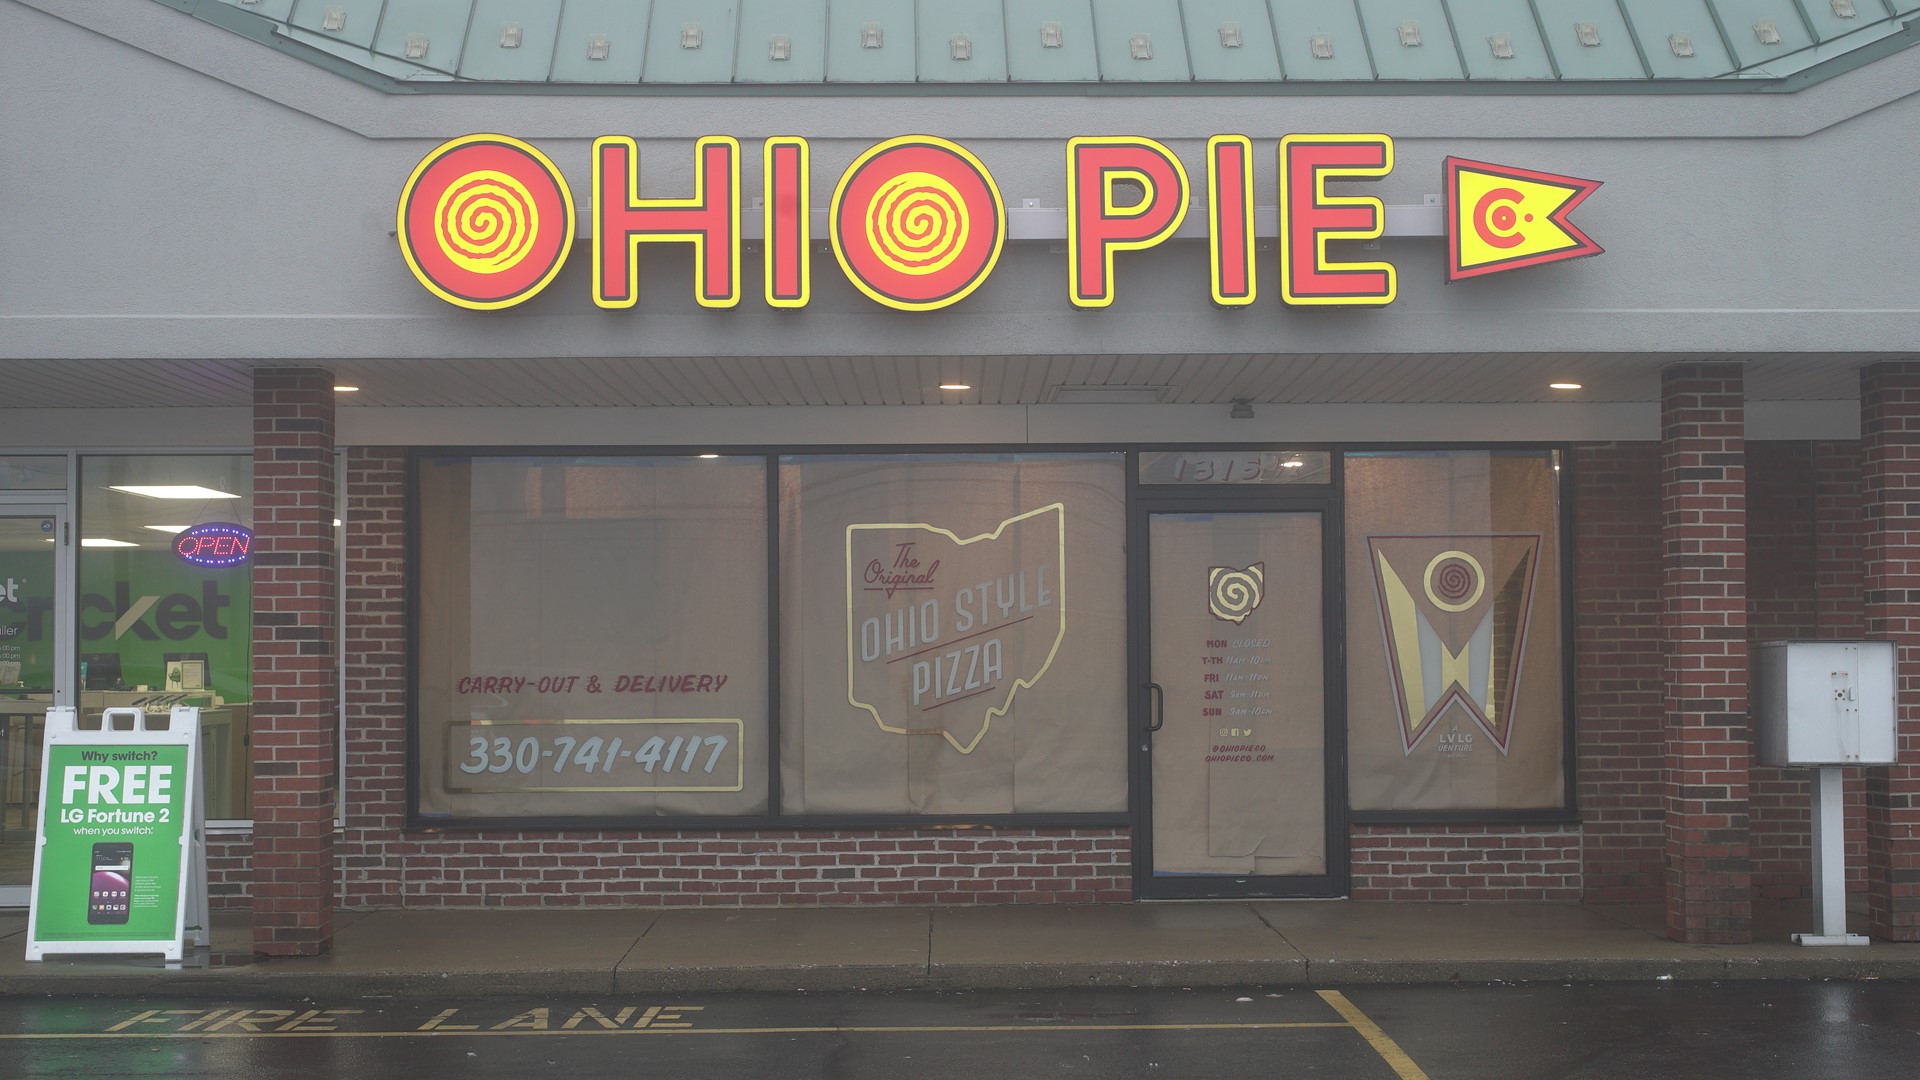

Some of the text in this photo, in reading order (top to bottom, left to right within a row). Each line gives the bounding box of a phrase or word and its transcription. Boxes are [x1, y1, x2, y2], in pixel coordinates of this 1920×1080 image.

[397, 133, 1397, 311] OHIO PIE
[177, 535, 251, 556] OPEN
[895, 542, 920, 569] The
[863, 559, 940, 599] Original
[860, 562, 1054, 662] OHIO STYLE
[1206, 638, 1271, 648] MON CLOSED
[1201, 656, 1223, 665] T-TH
[912, 638, 1003, 706] PIZZA
[1204, 674, 1219, 683] FRI
[456, 674, 729, 694] CARRY-OUT & DELIVERY
[1204, 690, 1225, 699] SAT
[1202, 708, 1222, 717] SUN
[81, 750, 158, 763] Why switch?
[459, 735, 729, 774] 330-741-4117
[61, 765, 173, 804] FREE
[60, 808, 170, 823] LG Fortune 2
[73, 826, 100, 835] when
[101, 827, 120, 837] you
[104, 1006, 704, 1031] FIRE LANE
